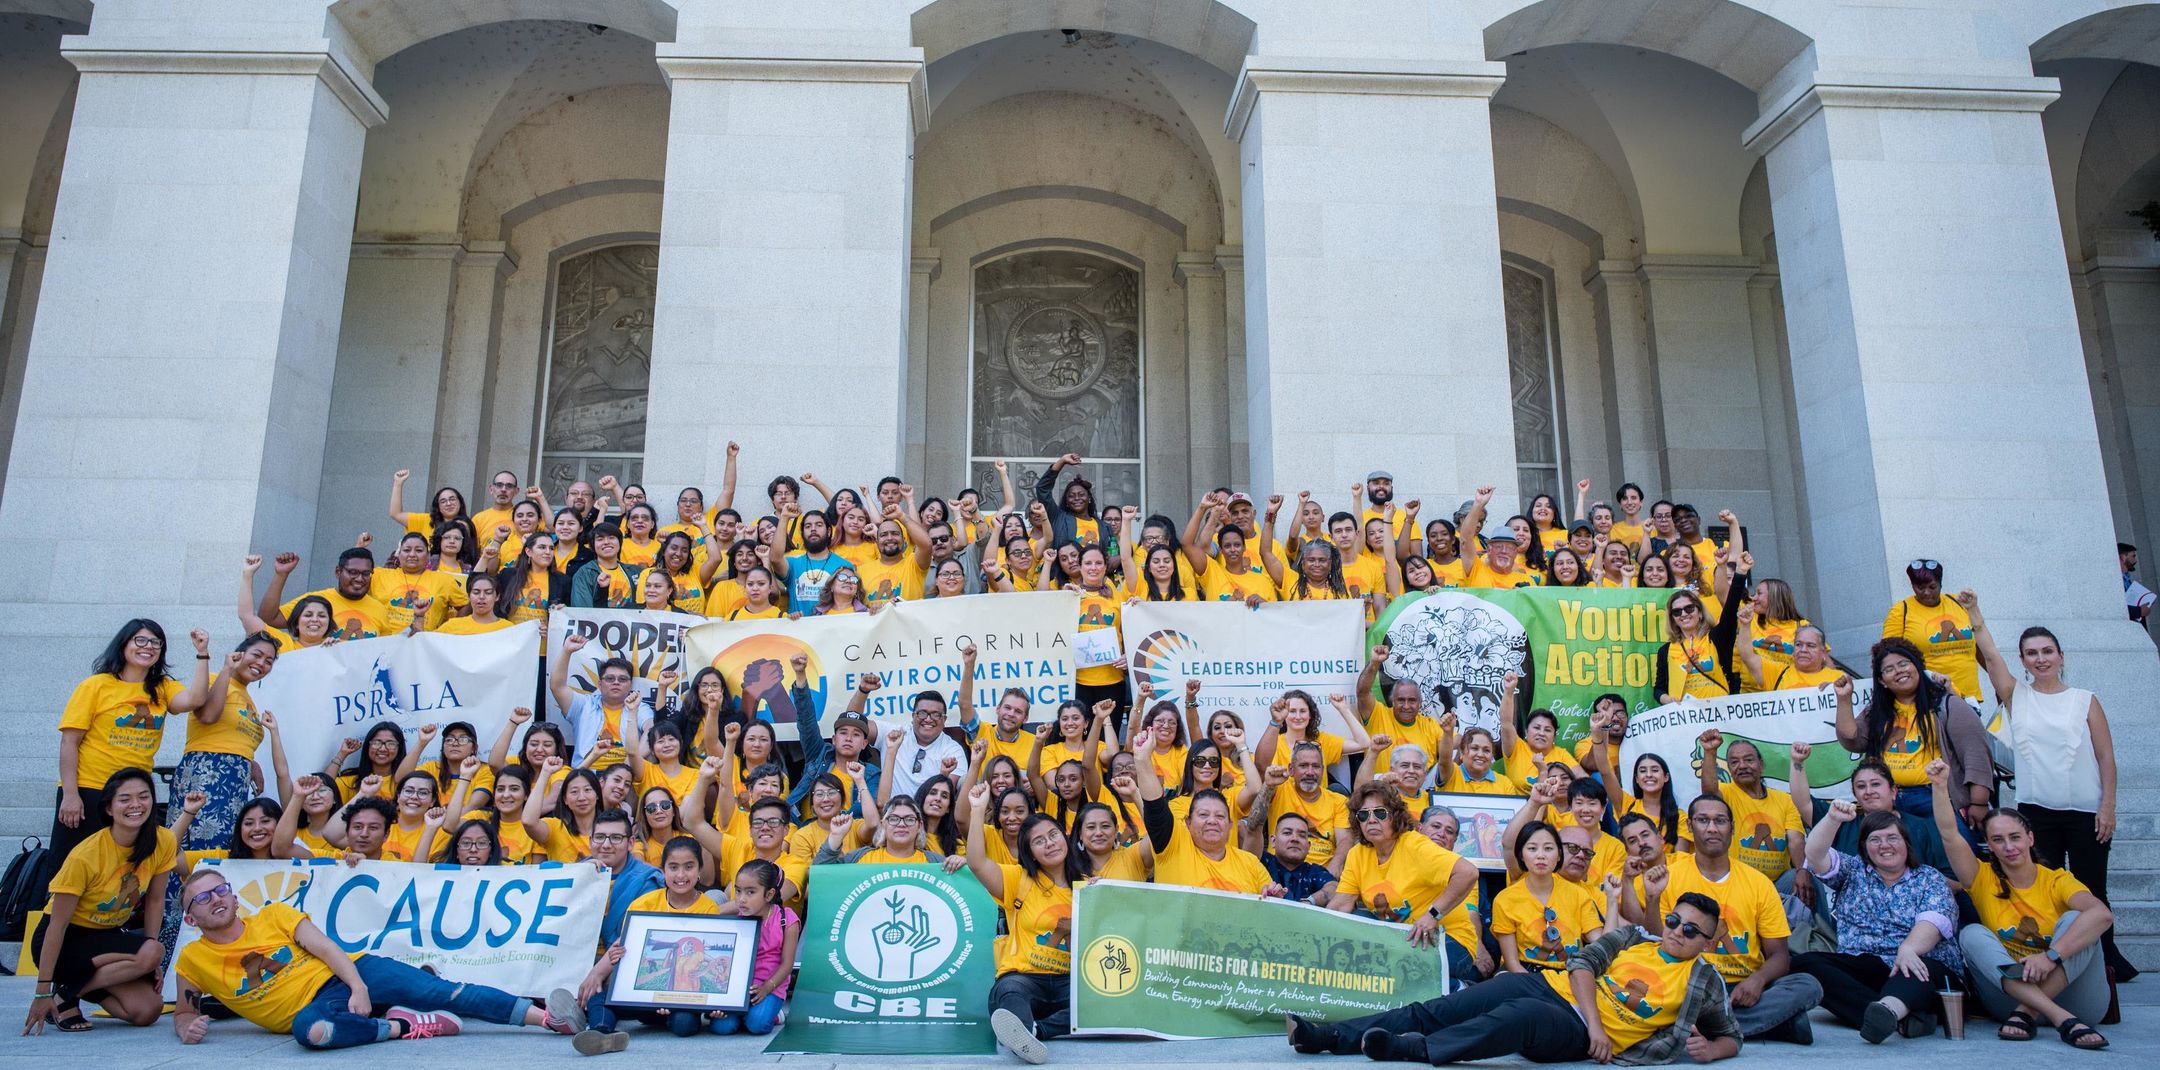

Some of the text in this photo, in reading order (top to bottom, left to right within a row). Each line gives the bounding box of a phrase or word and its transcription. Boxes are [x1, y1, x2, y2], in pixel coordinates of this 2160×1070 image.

[1558, 599, 1668, 643] Youth
[844, 631, 1067, 662] CALIFORNIA
[846, 659, 1068, 691] EVIRONMENTAL
[1182, 659, 1360, 676] LEADERSHIP COUNSEL
[1196, 695, 1236, 707] STICE
[1239, 695, 1249, 707] &
[1262, 681, 1285, 690] FOR
[333, 680, 463, 726] PSR LA
[1549, 698, 1594, 717] Rooted
[1624, 717, 1667, 739] CENTRO
[1670, 712, 1688, 732] EN
[1690, 707, 1726, 724] RAZA,
[1727, 700, 1786, 721] POBREZA
[1788, 699, 1796, 713] Y
[1799, 696, 1816, 713] EL
[1818, 690, 1860, 710] MEO
[326, 873, 574, 954] CAUSE
[830, 869, 974, 942] COMMUNITIES FOR A BETTER ENVIRONMENT
[450, 952, 505, 967] Sustainable
[507, 950, 556, 968] Economy
[1145, 947, 1396, 995] COMMUNITIES FOR A BETTER ENVIRONMENT
[856, 980, 921, 995] environmental
[922, 972, 951, 989] health
[948, 967, 957, 975] &
[1144, 969, 1180, 989] Building
[1182, 975, 1233, 997] Community
[1236, 980, 1265, 996] Power
[1267, 987, 1275, 997] to
[1277, 985, 1316, 1003] Achieve
[1320, 992, 1391, 1012] Environmental
[833, 990, 958, 1018] CBE
[1145, 986, 1327, 1020] Clean Energy and Healthy Communities
